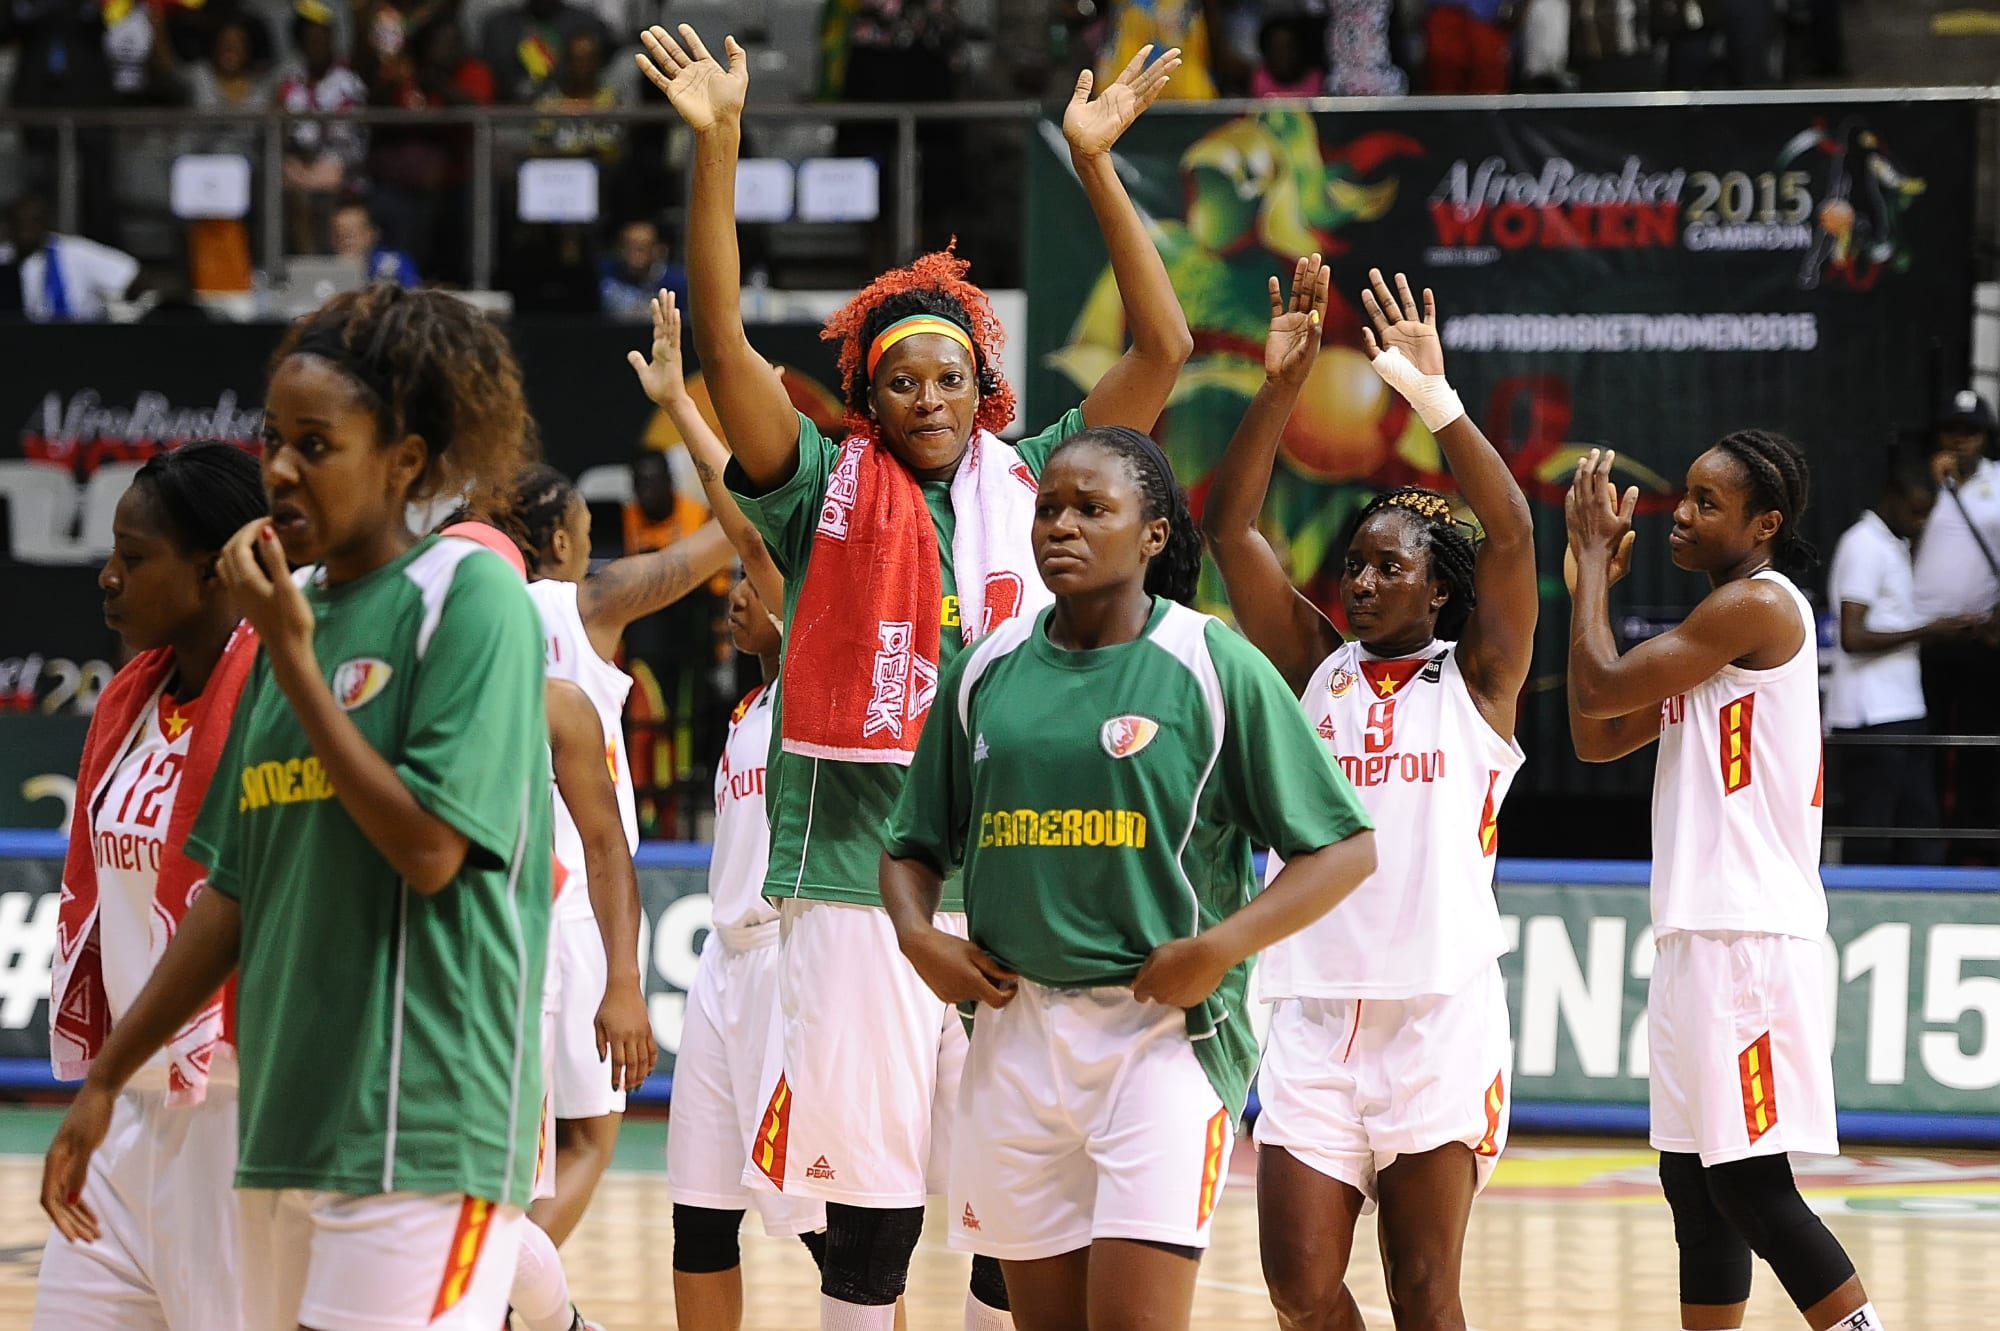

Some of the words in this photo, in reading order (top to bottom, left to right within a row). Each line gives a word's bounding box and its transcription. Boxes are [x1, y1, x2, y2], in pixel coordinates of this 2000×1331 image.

[1686, 170, 1813, 226] 2015
[1430, 200, 1678, 248] WOMEN
[862, 621, 912, 740] PEAK
[1364, 699, 1397, 753] 9
[116, 752, 187, 828] 12
[1333, 749, 1445, 787] meroun
[95, 830, 161, 872] mero
[979, 808, 1146, 849] CAMEROUN
[805, 1167, 837, 1180] PEAK
